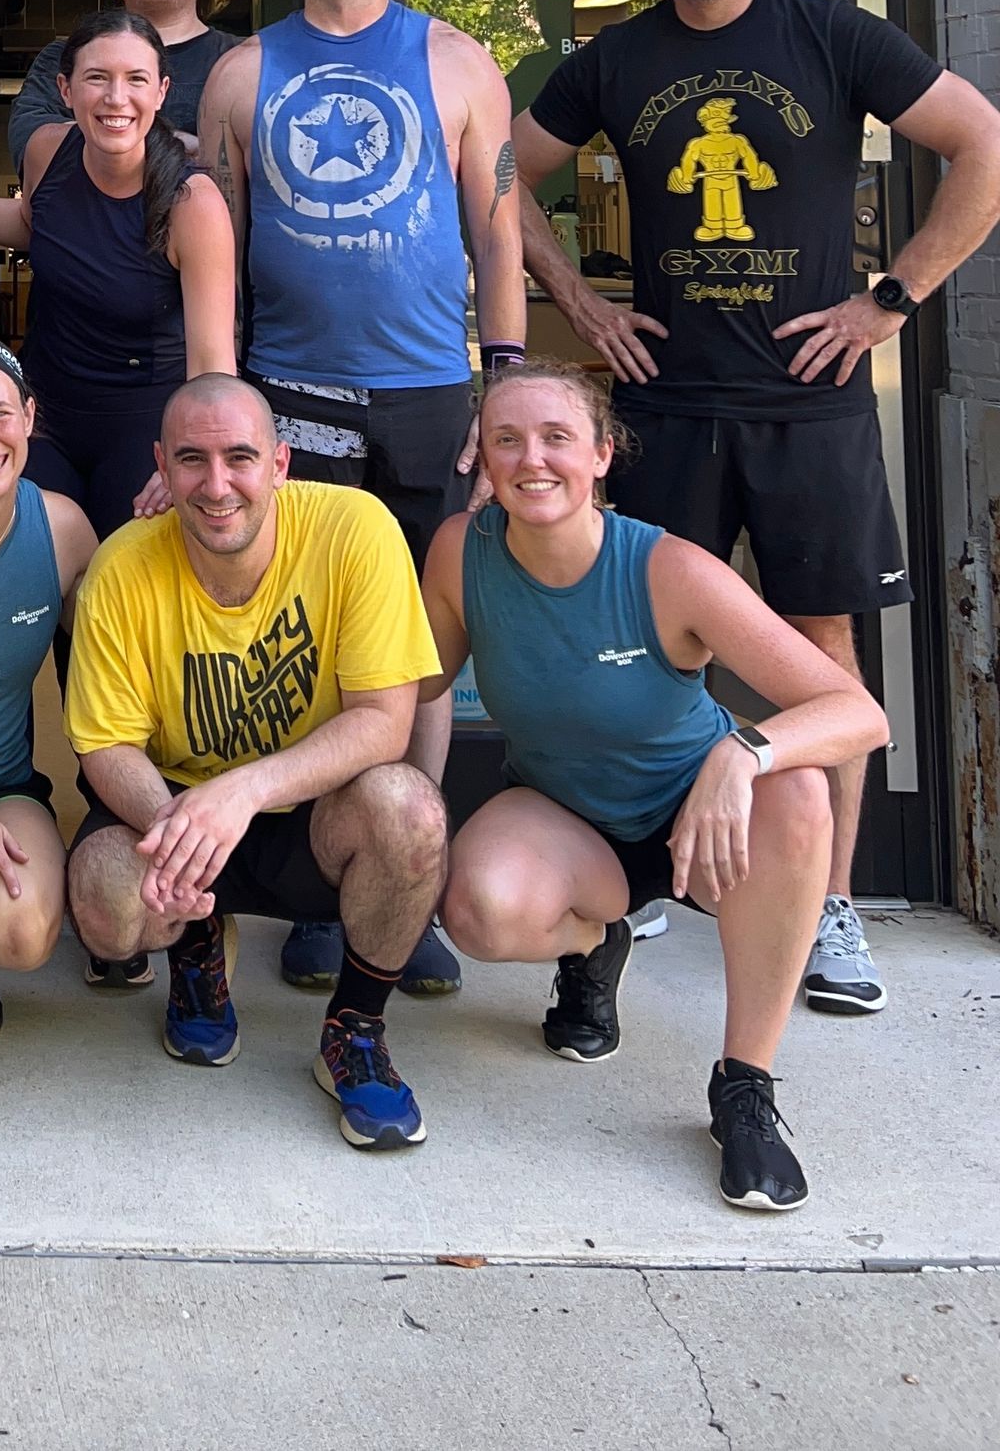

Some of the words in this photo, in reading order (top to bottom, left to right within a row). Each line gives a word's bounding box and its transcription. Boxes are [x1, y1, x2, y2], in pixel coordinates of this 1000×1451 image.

[628, 69, 815, 147] WILLY'S
[659, 248, 799, 276] GYM
[240, 594, 313, 706] CITY
[598, 647, 648, 662] DOWNTOWN
[248, 645, 318, 756] CREW
